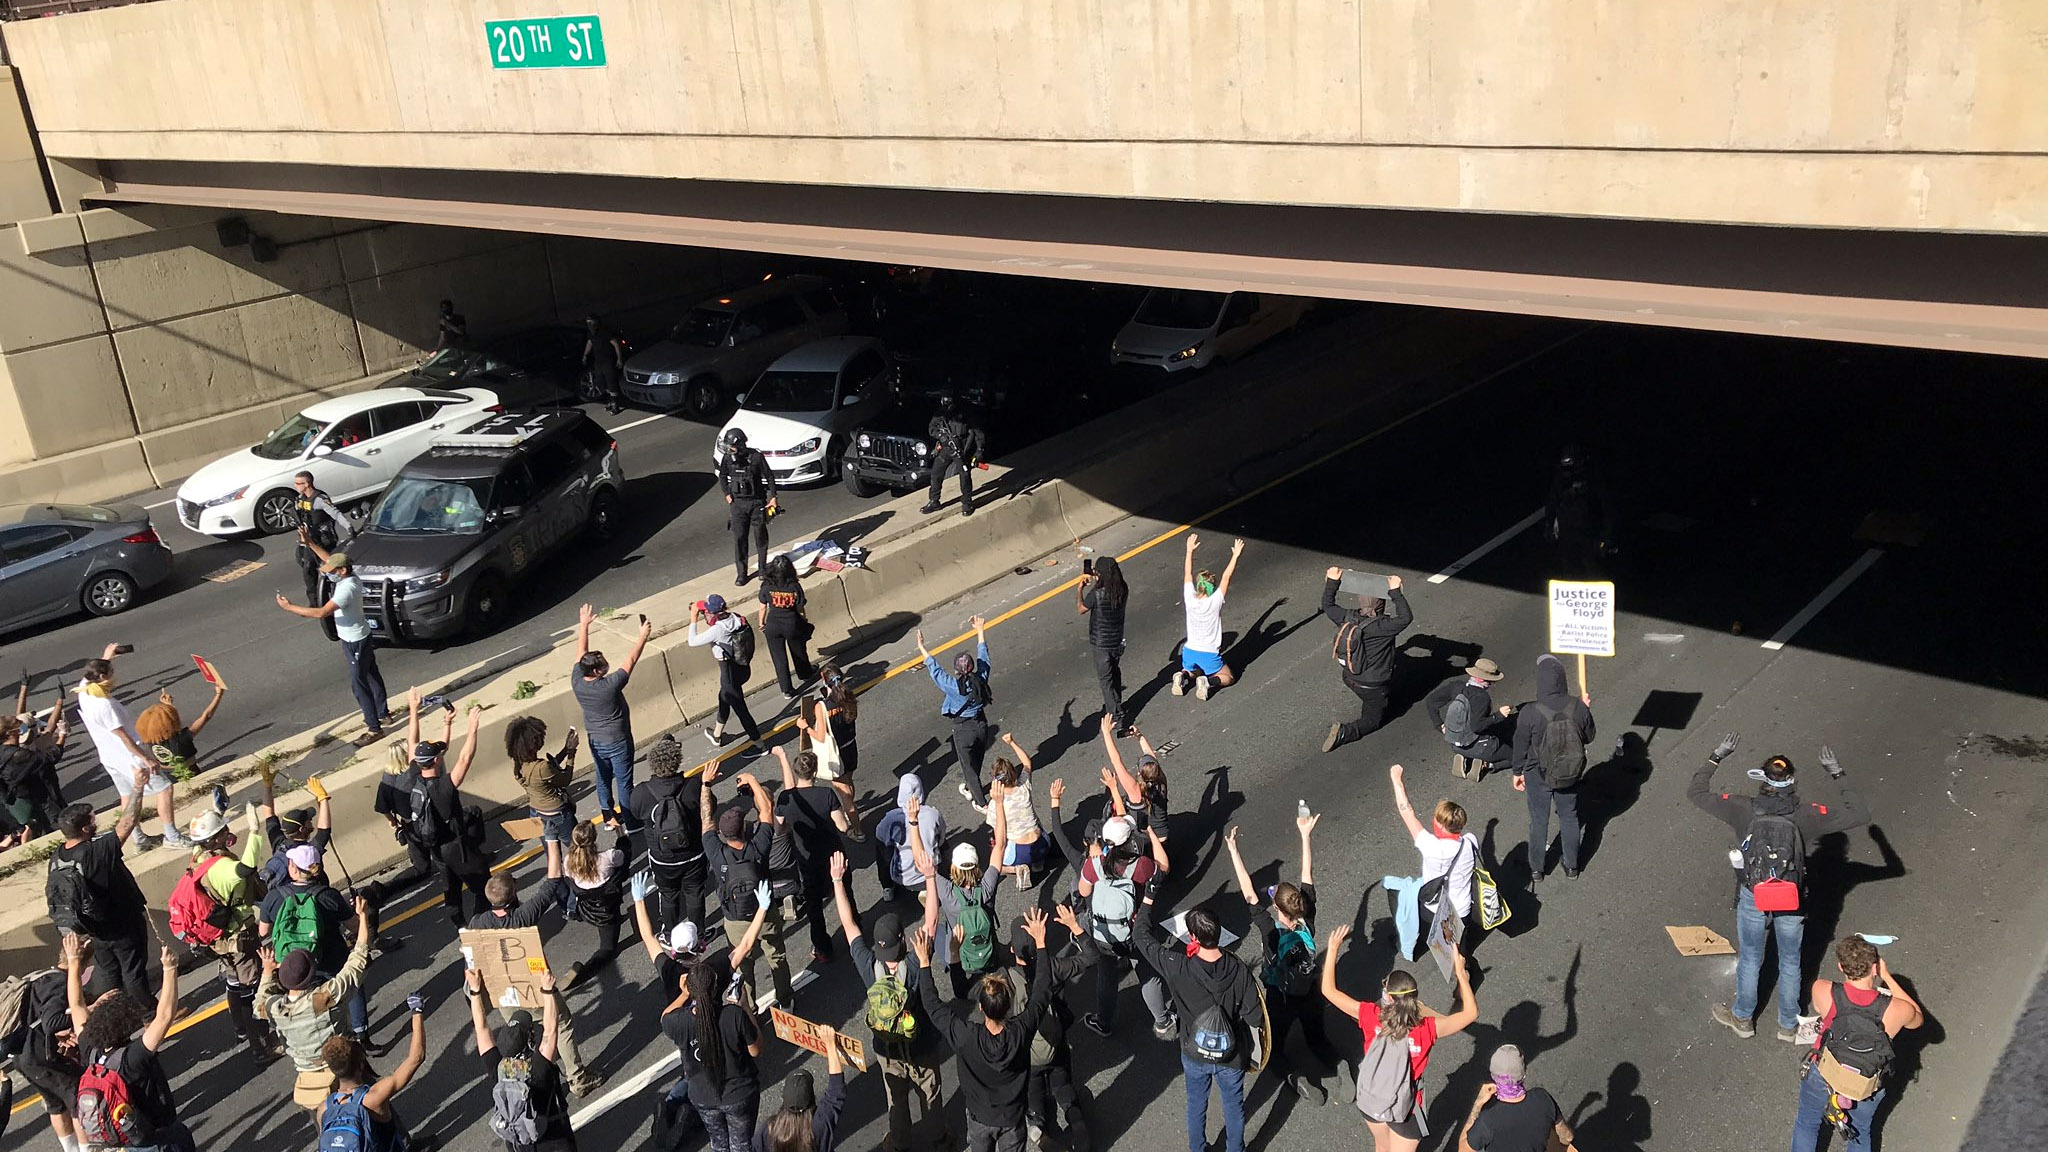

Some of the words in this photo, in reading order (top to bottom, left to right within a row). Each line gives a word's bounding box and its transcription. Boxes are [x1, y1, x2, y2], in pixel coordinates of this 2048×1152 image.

[493, 25, 552, 62] 20TH
[566, 22, 593, 60] ST
[1554, 588, 1607, 600] Justice
[1565, 599, 1608, 610] George
[1573, 608, 1604, 619] Floyd
[774, 1011, 797, 1029] NO
